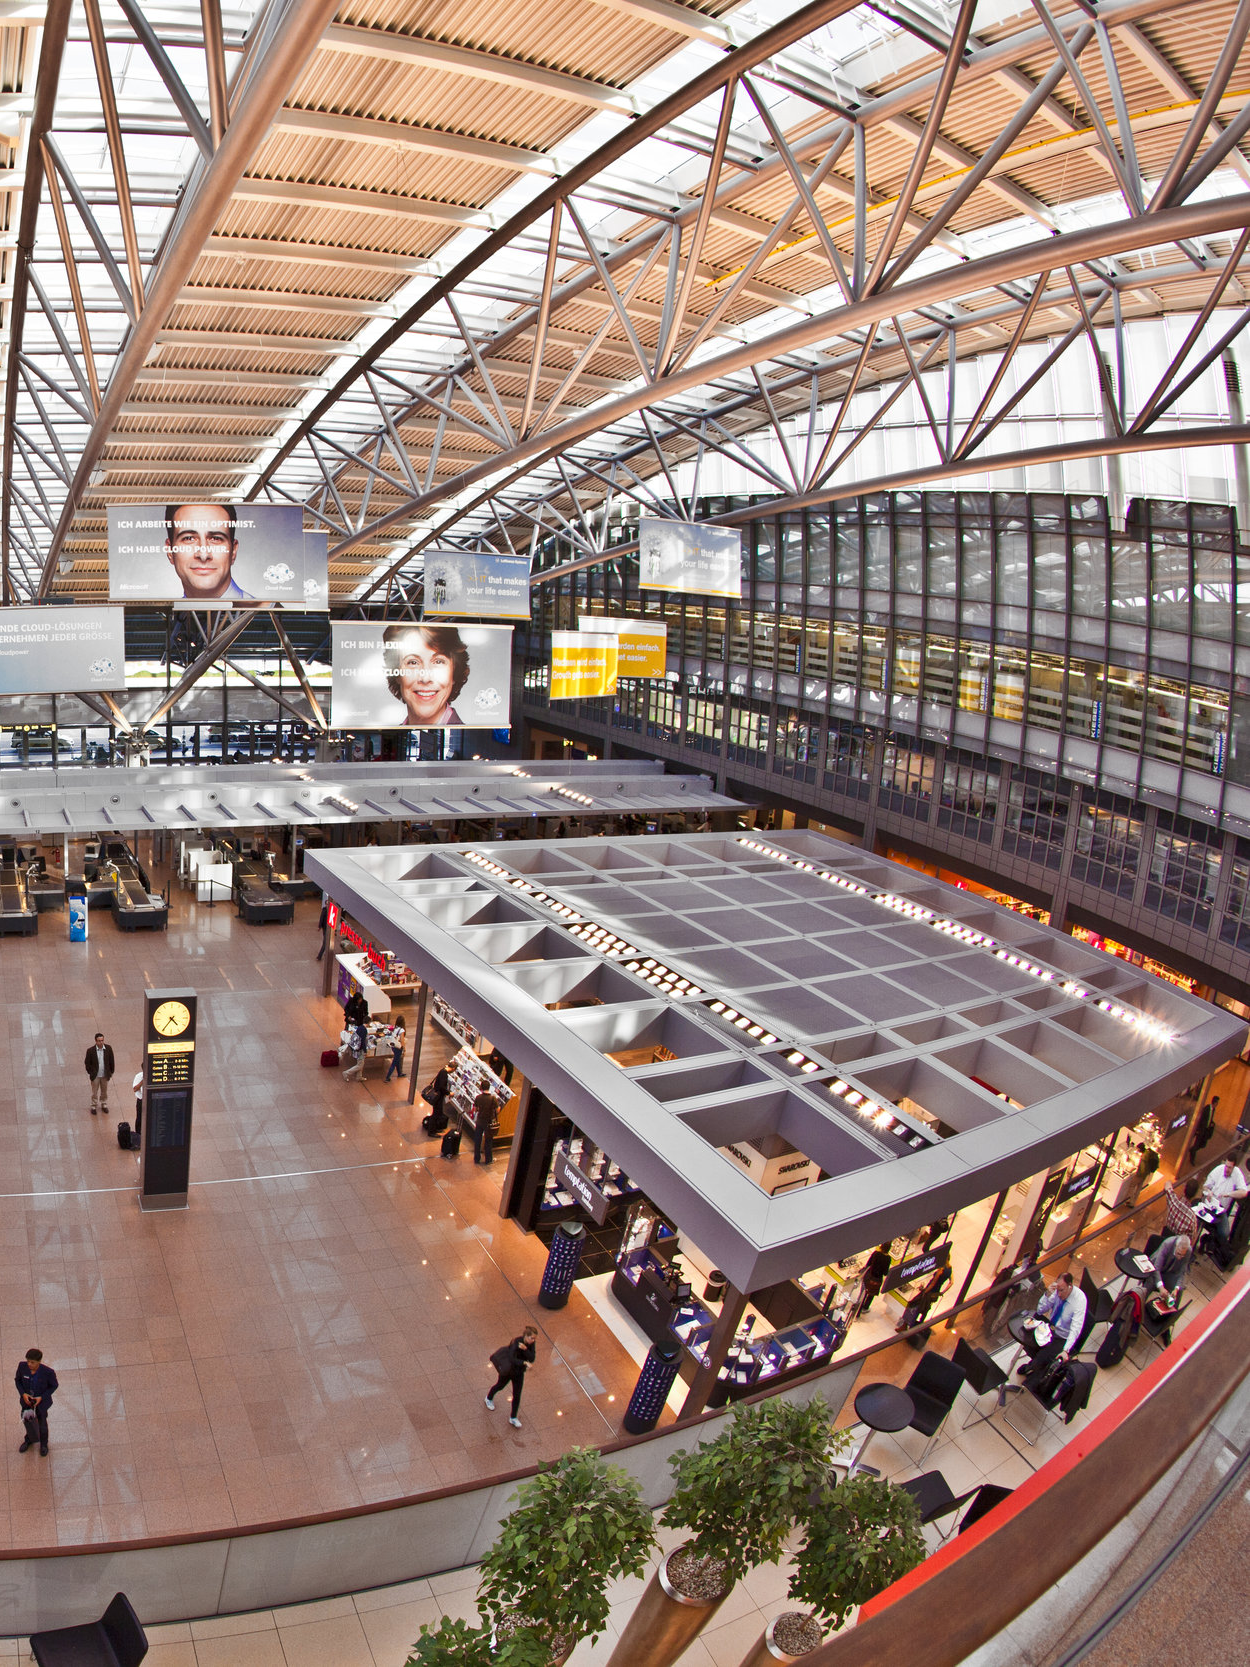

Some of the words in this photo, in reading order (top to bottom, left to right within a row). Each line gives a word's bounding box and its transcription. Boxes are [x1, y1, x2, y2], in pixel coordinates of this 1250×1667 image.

[117, 520, 134, 529] ICH
[135, 520, 172, 529] ARBEITE
[173, 520, 193, 528] WIE
[193, 520, 208, 528] EIN
[211, 520, 256, 528] OPTIMIST.
[118, 546, 134, 554] ICH
[136, 545, 161, 554] HABE
[162, 545, 193, 553] CLOUD
[194, 545, 230, 553] POWER.
[681, 560, 697, 569] your
[697, 560, 709, 570] life
[488, 576, 503, 584] that
[503, 577, 527, 586] makes
[466, 587, 483, 595] your
[484, 587, 496, 596] life
[497, 588, 521, 597] easier.
[20, 622, 103, 633] CLOUD-LÖSUNGEN
[50, 632, 77, 642] JEDER
[78, 631, 115, 641] GRÖSSE.
[341, 640, 356, 649] ICH
[358, 640, 374, 649] BIN
[636, 642, 661, 652] einfach.
[626, 654, 648, 662] easier.
[341, 668, 357, 677] ICH
[385, 668, 412, 677] CLOUD
[1213, 731, 1222, 773] KIESER
[329, 905, 336, 926] k
[340, 920, 363, 950] presse
[368, 941, 386, 973] buch
[778, 1159, 810, 1175] SWAROVSKI
[564, 1164, 592, 1201] temptation
